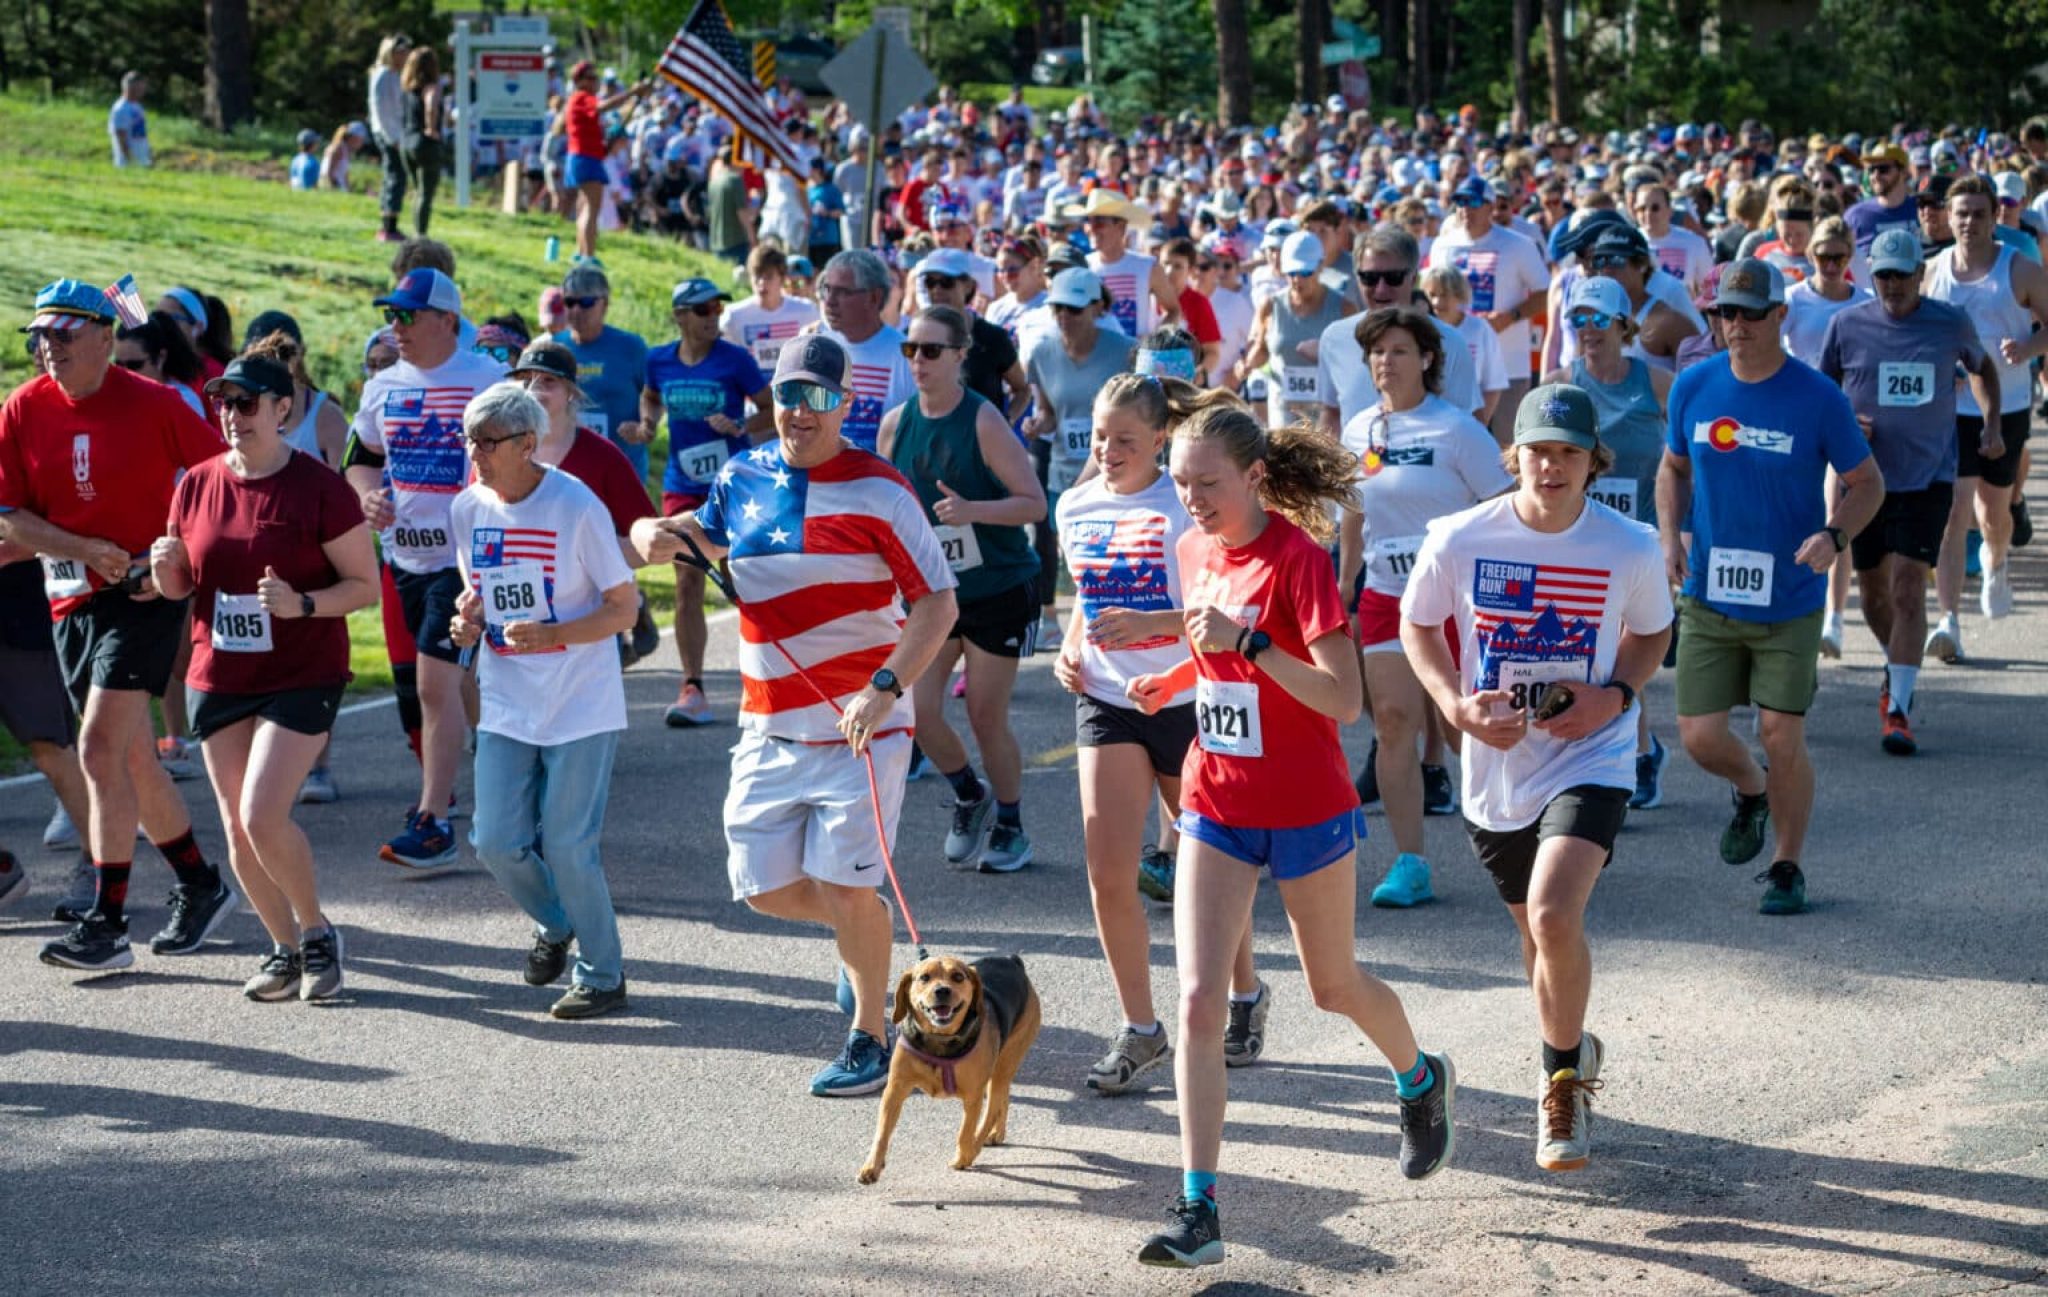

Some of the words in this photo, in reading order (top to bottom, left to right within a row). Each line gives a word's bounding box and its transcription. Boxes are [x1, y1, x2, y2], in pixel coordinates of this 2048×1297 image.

[1887, 375, 1923, 396] 264
[395, 527, 447, 547] 8069
[1480, 563, 1532, 582] FREEDOM
[1715, 565, 1765, 591] 1109
[493, 582, 536, 611] 658
[1479, 578, 1506, 596] RUN!
[1509, 682, 1554, 710] 80
[1200, 702, 1249, 738] 8121
